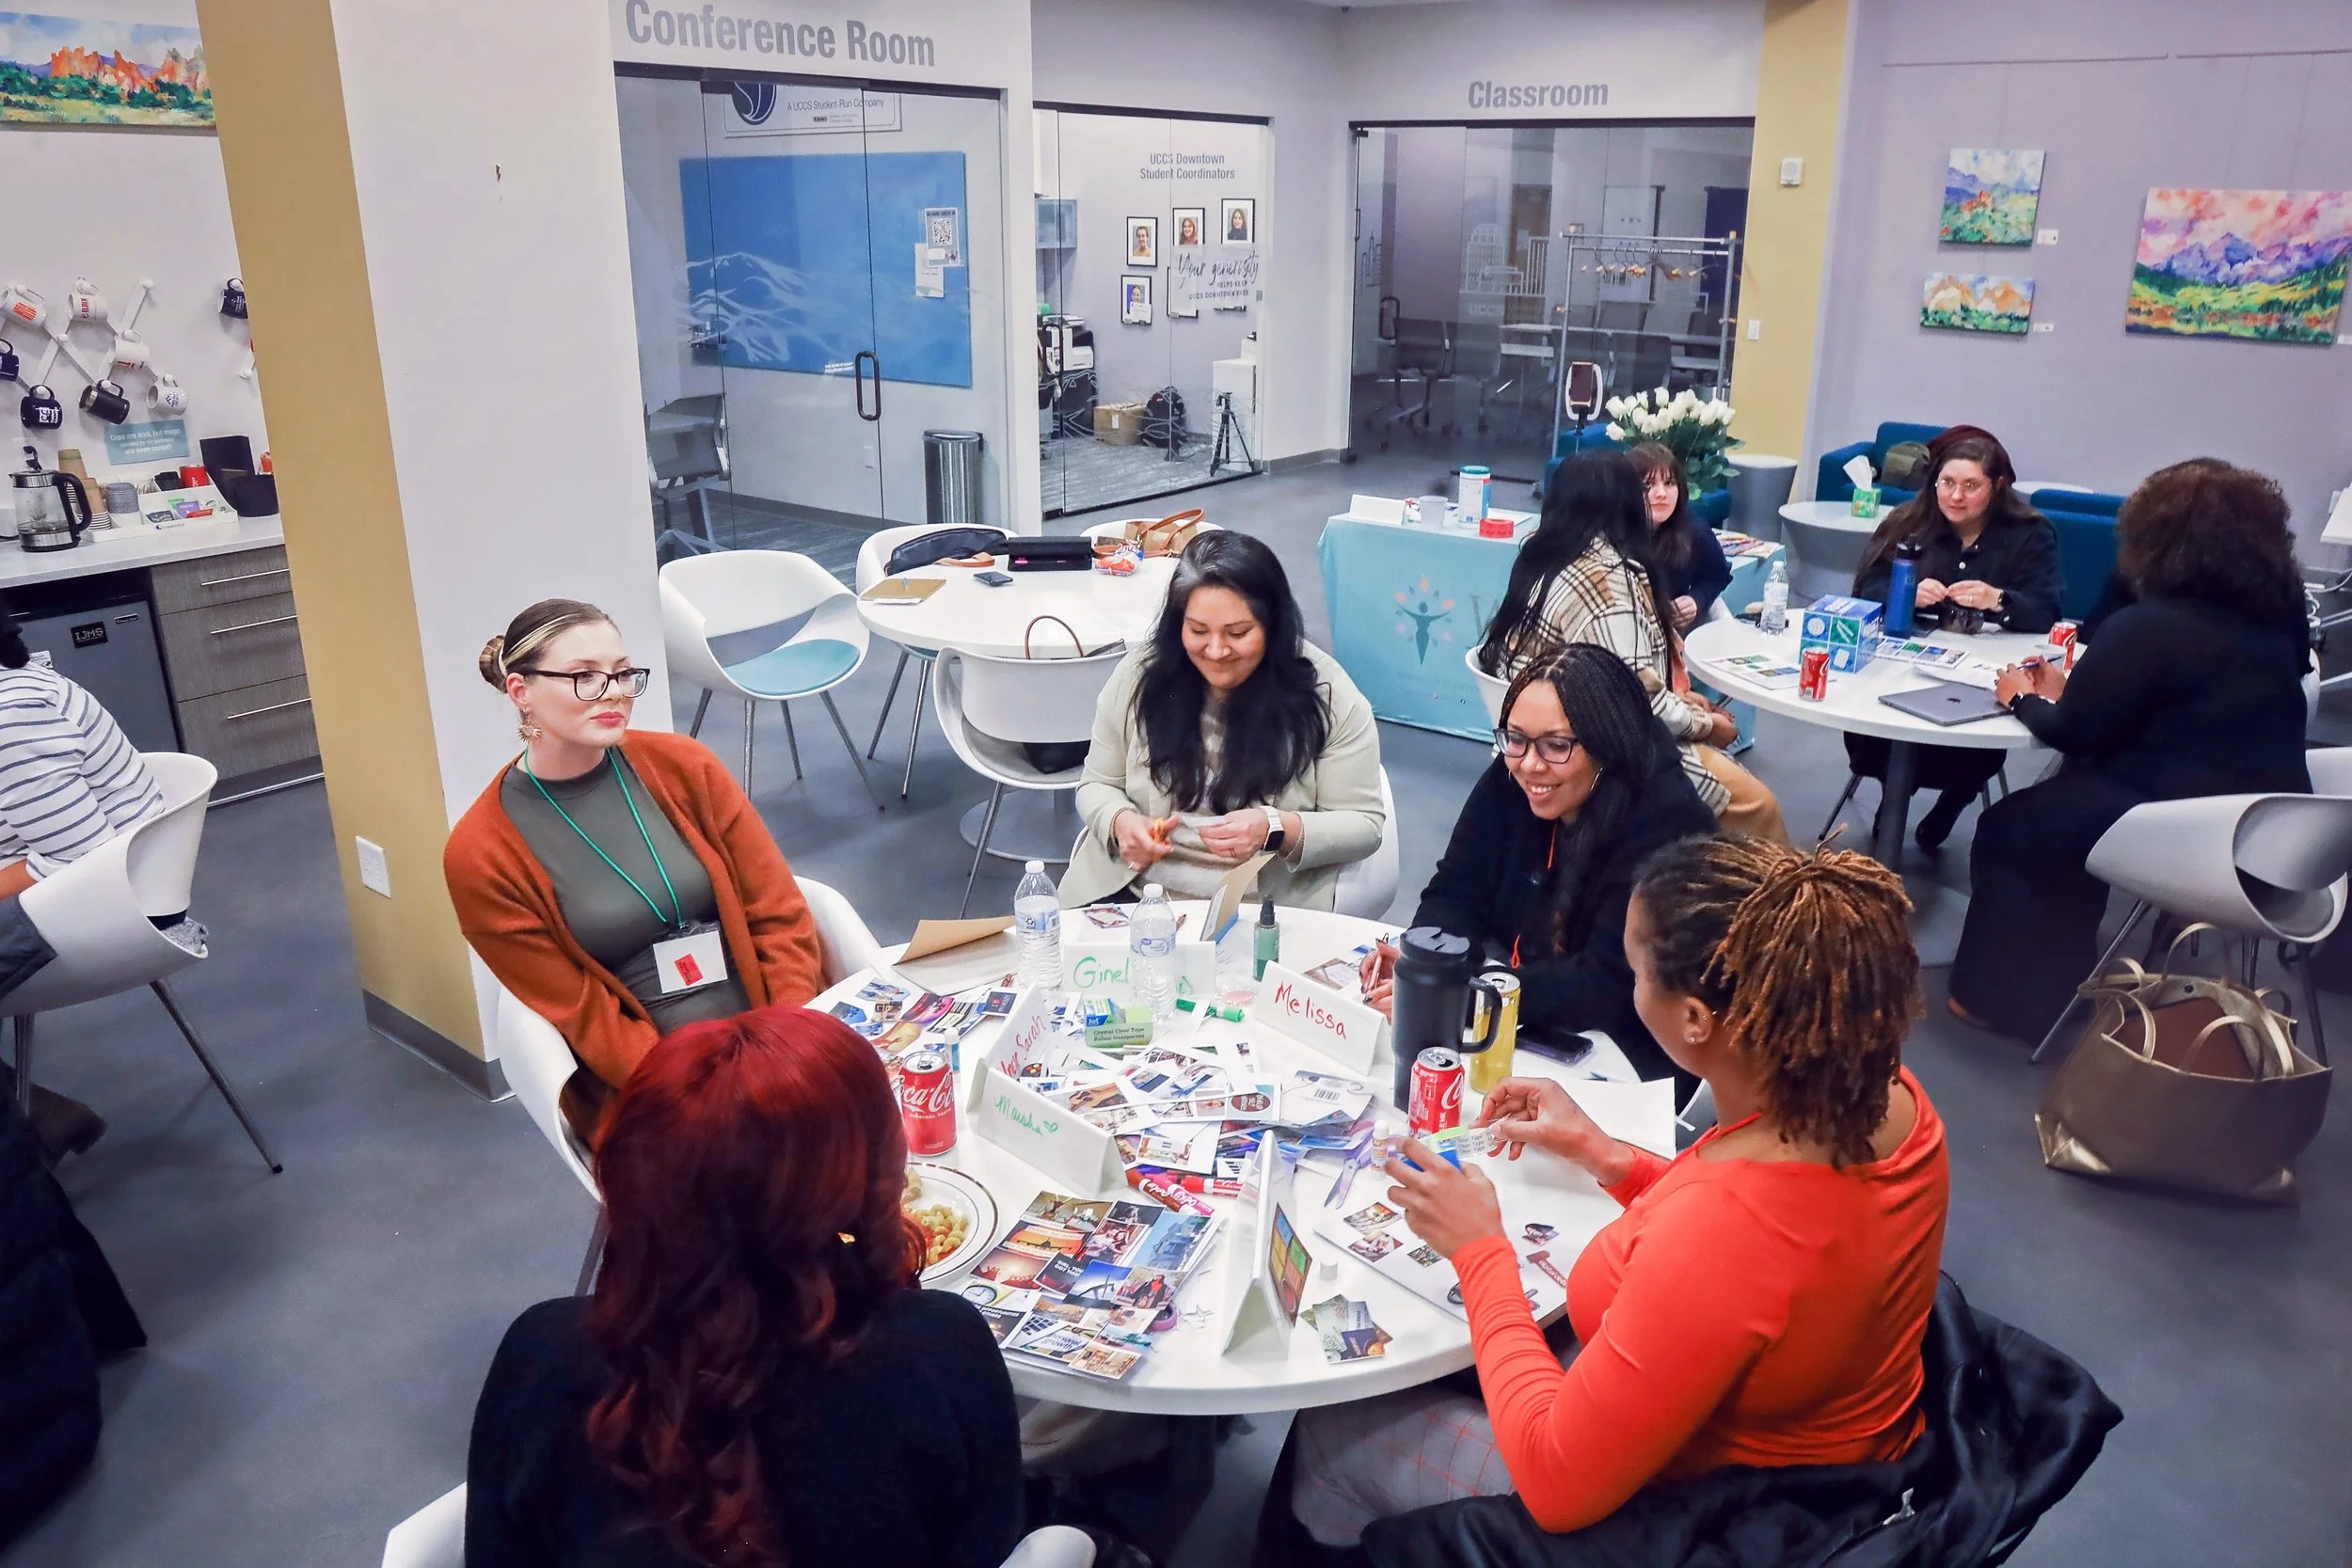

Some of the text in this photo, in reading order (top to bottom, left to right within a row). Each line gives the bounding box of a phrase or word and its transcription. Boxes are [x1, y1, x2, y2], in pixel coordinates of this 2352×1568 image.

[626, 0, 935, 67] Conference Room
[787, 98, 884, 112] A UCCS Student-Run Company
[1469, 80, 1609, 109] Classroom
[1139, 167, 1235, 180] Student Coordinators
[1150, 152, 1225, 165] UCCS Downtown
[1178, 249, 1259, 289] Your generosity
[1073, 956, 1129, 988] Ginel
[1274, 981, 1347, 1040] Melissa
[1016, 1015, 1046, 1060] Sarah
[1173, 1190, 1198, 1207] EXPO
